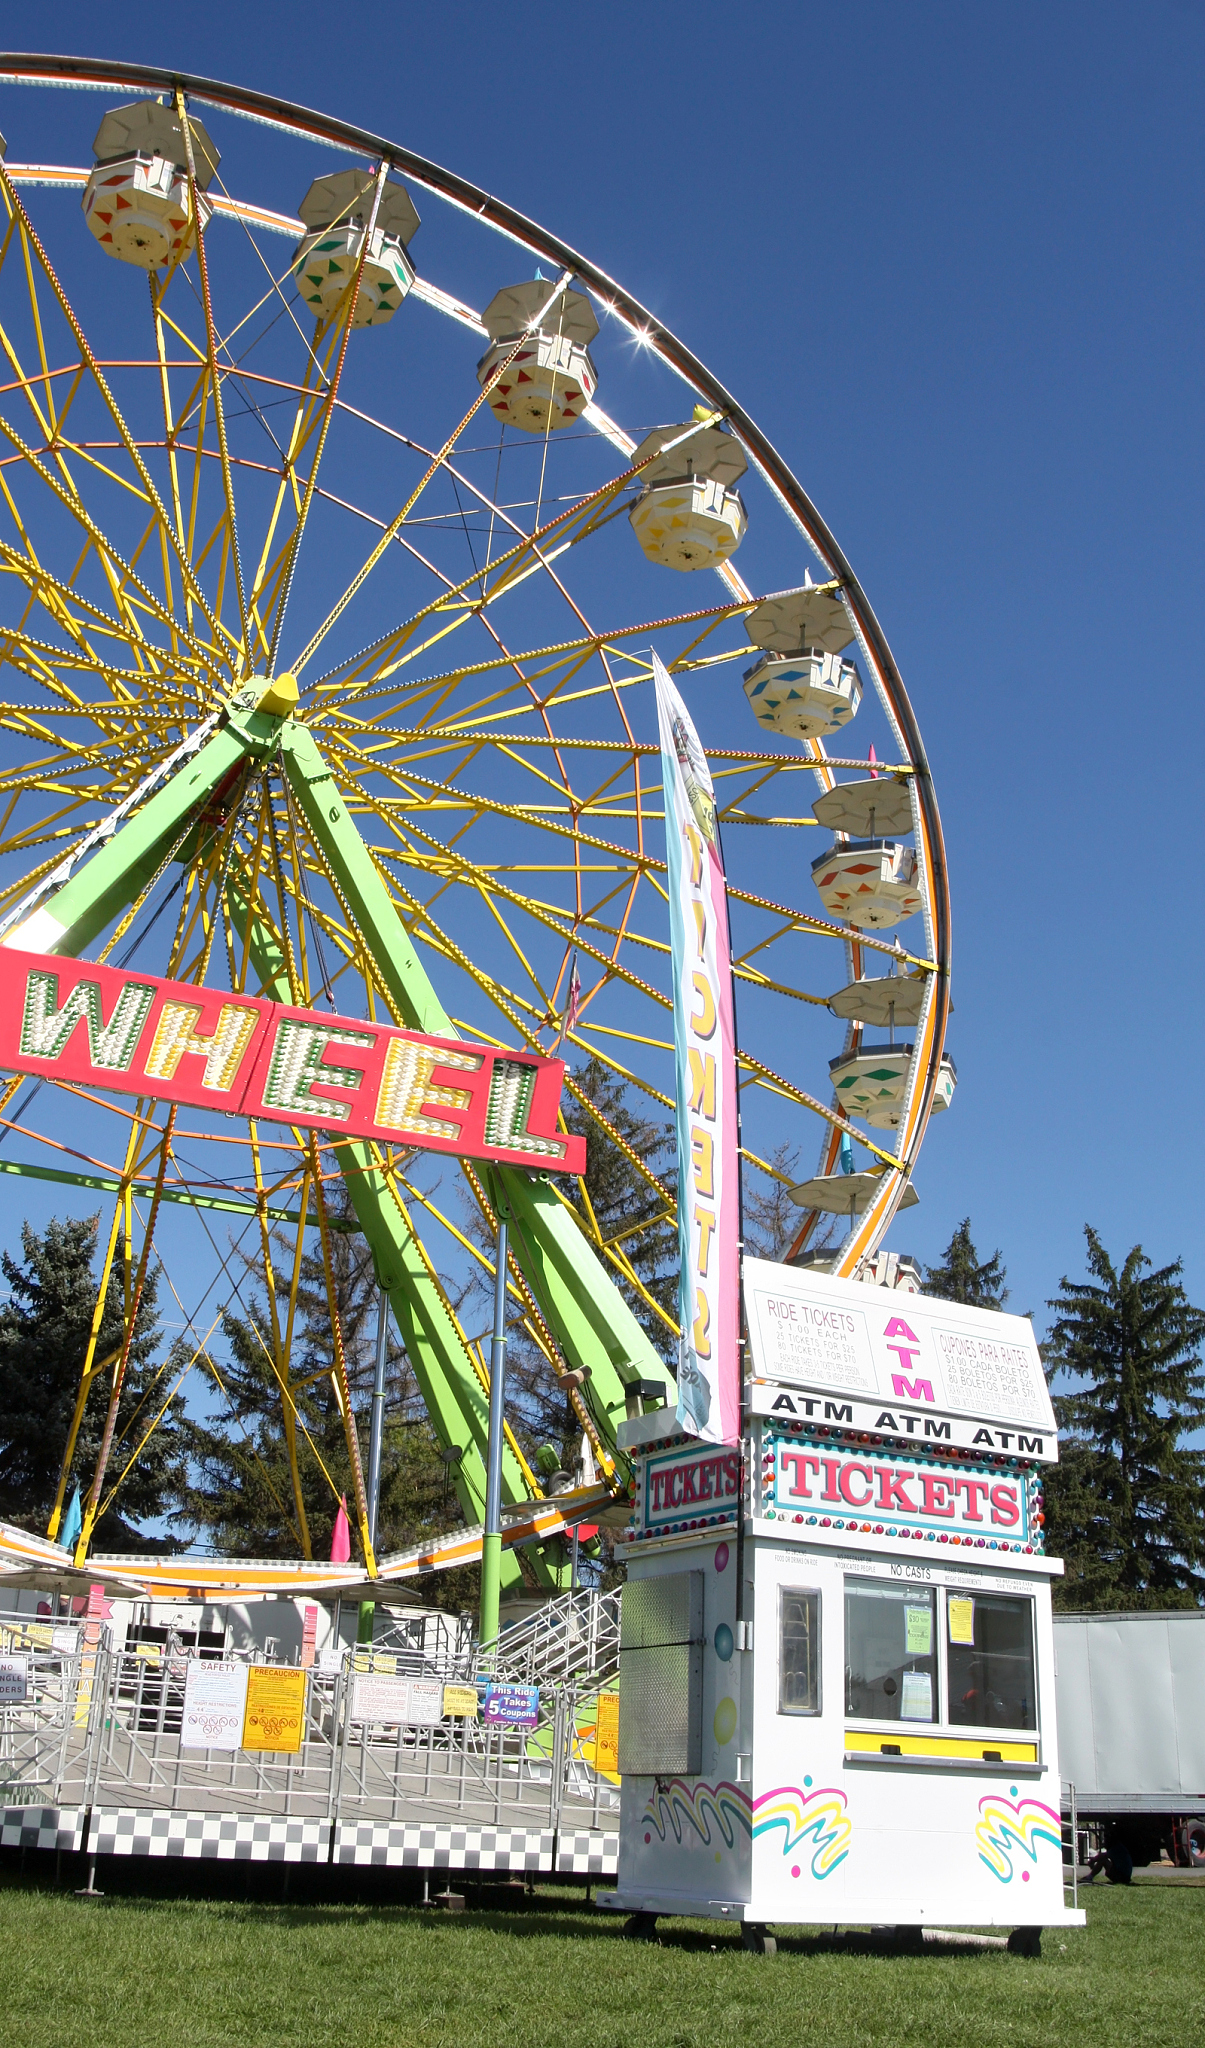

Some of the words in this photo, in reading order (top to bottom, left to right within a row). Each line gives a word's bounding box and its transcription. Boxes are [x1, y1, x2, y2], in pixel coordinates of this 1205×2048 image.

[18, 968, 567, 1160] WHEEL
[767, 1300, 798, 1321] RIDE
[802, 1307, 855, 1332] TICKETS
[776, 1331, 785, 1340] 25
[788, 1333, 820, 1347] TICKETS
[823, 1341, 839, 1351] FOR
[842, 1343, 856, 1354] $25
[817, 1329, 847, 1342] EACH
[777, 1342, 787, 1351] 80
[790, 1343, 822, 1358] TICKETS
[826, 1351, 841, 1360] FOR
[843, 1353, 857, 1364] $70
[883, 1317, 935, 1402] ATM
[940, 1334, 977, 1359] CUPONES
[978, 1342, 1000, 1363] PARA
[1000, 1347, 1029, 1369] RAITES
[945, 1354, 967, 1366] $1.00
[969, 1359, 993, 1372] CADA
[995, 1364, 1030, 1379] BOLETO
[947, 1365, 957, 1374] 25
[959, 1367, 997, 1382] BOLETOS
[1000, 1374, 1018, 1386] POR
[1020, 1378, 1034, 1389] $25
[948, 1373, 958, 1384] 80
[961, 1375, 999, 1392] BOLETOS
[1002, 1384, 1020, 1396] POR
[1023, 1388, 1036, 1399] $70
[771, 1393, 853, 1423] ATM
[874, 1412, 951, 1439] ATM
[972, 1428, 1044, 1454] ATM
[650, 1452, 739, 1512] TICKETS
[781, 1452, 1020, 1527] TICKETS
[774, 1554, 785, 1562] FOOD
[810, 1558, 819, 1566] RIDE
[834, 1561, 860, 1571] INTOXICATED
[860, 1563, 876, 1573] PEOPLE
[843, 1554, 866, 1563] PREGNANT
[890, 1564, 902, 1576] NO
[905, 1566, 931, 1580] CASTS
[200, 1662, 237, 1672] SAFETY
[254, 1668, 300, 1678] PRECAUCIÓN
[492, 1686, 511, 1695] This
[514, 1687, 535, 1697] Ride
[503, 1697, 532, 1707] Takes
[488, 1700, 500, 1716] 5
[500, 1708, 536, 1718] Coupons
